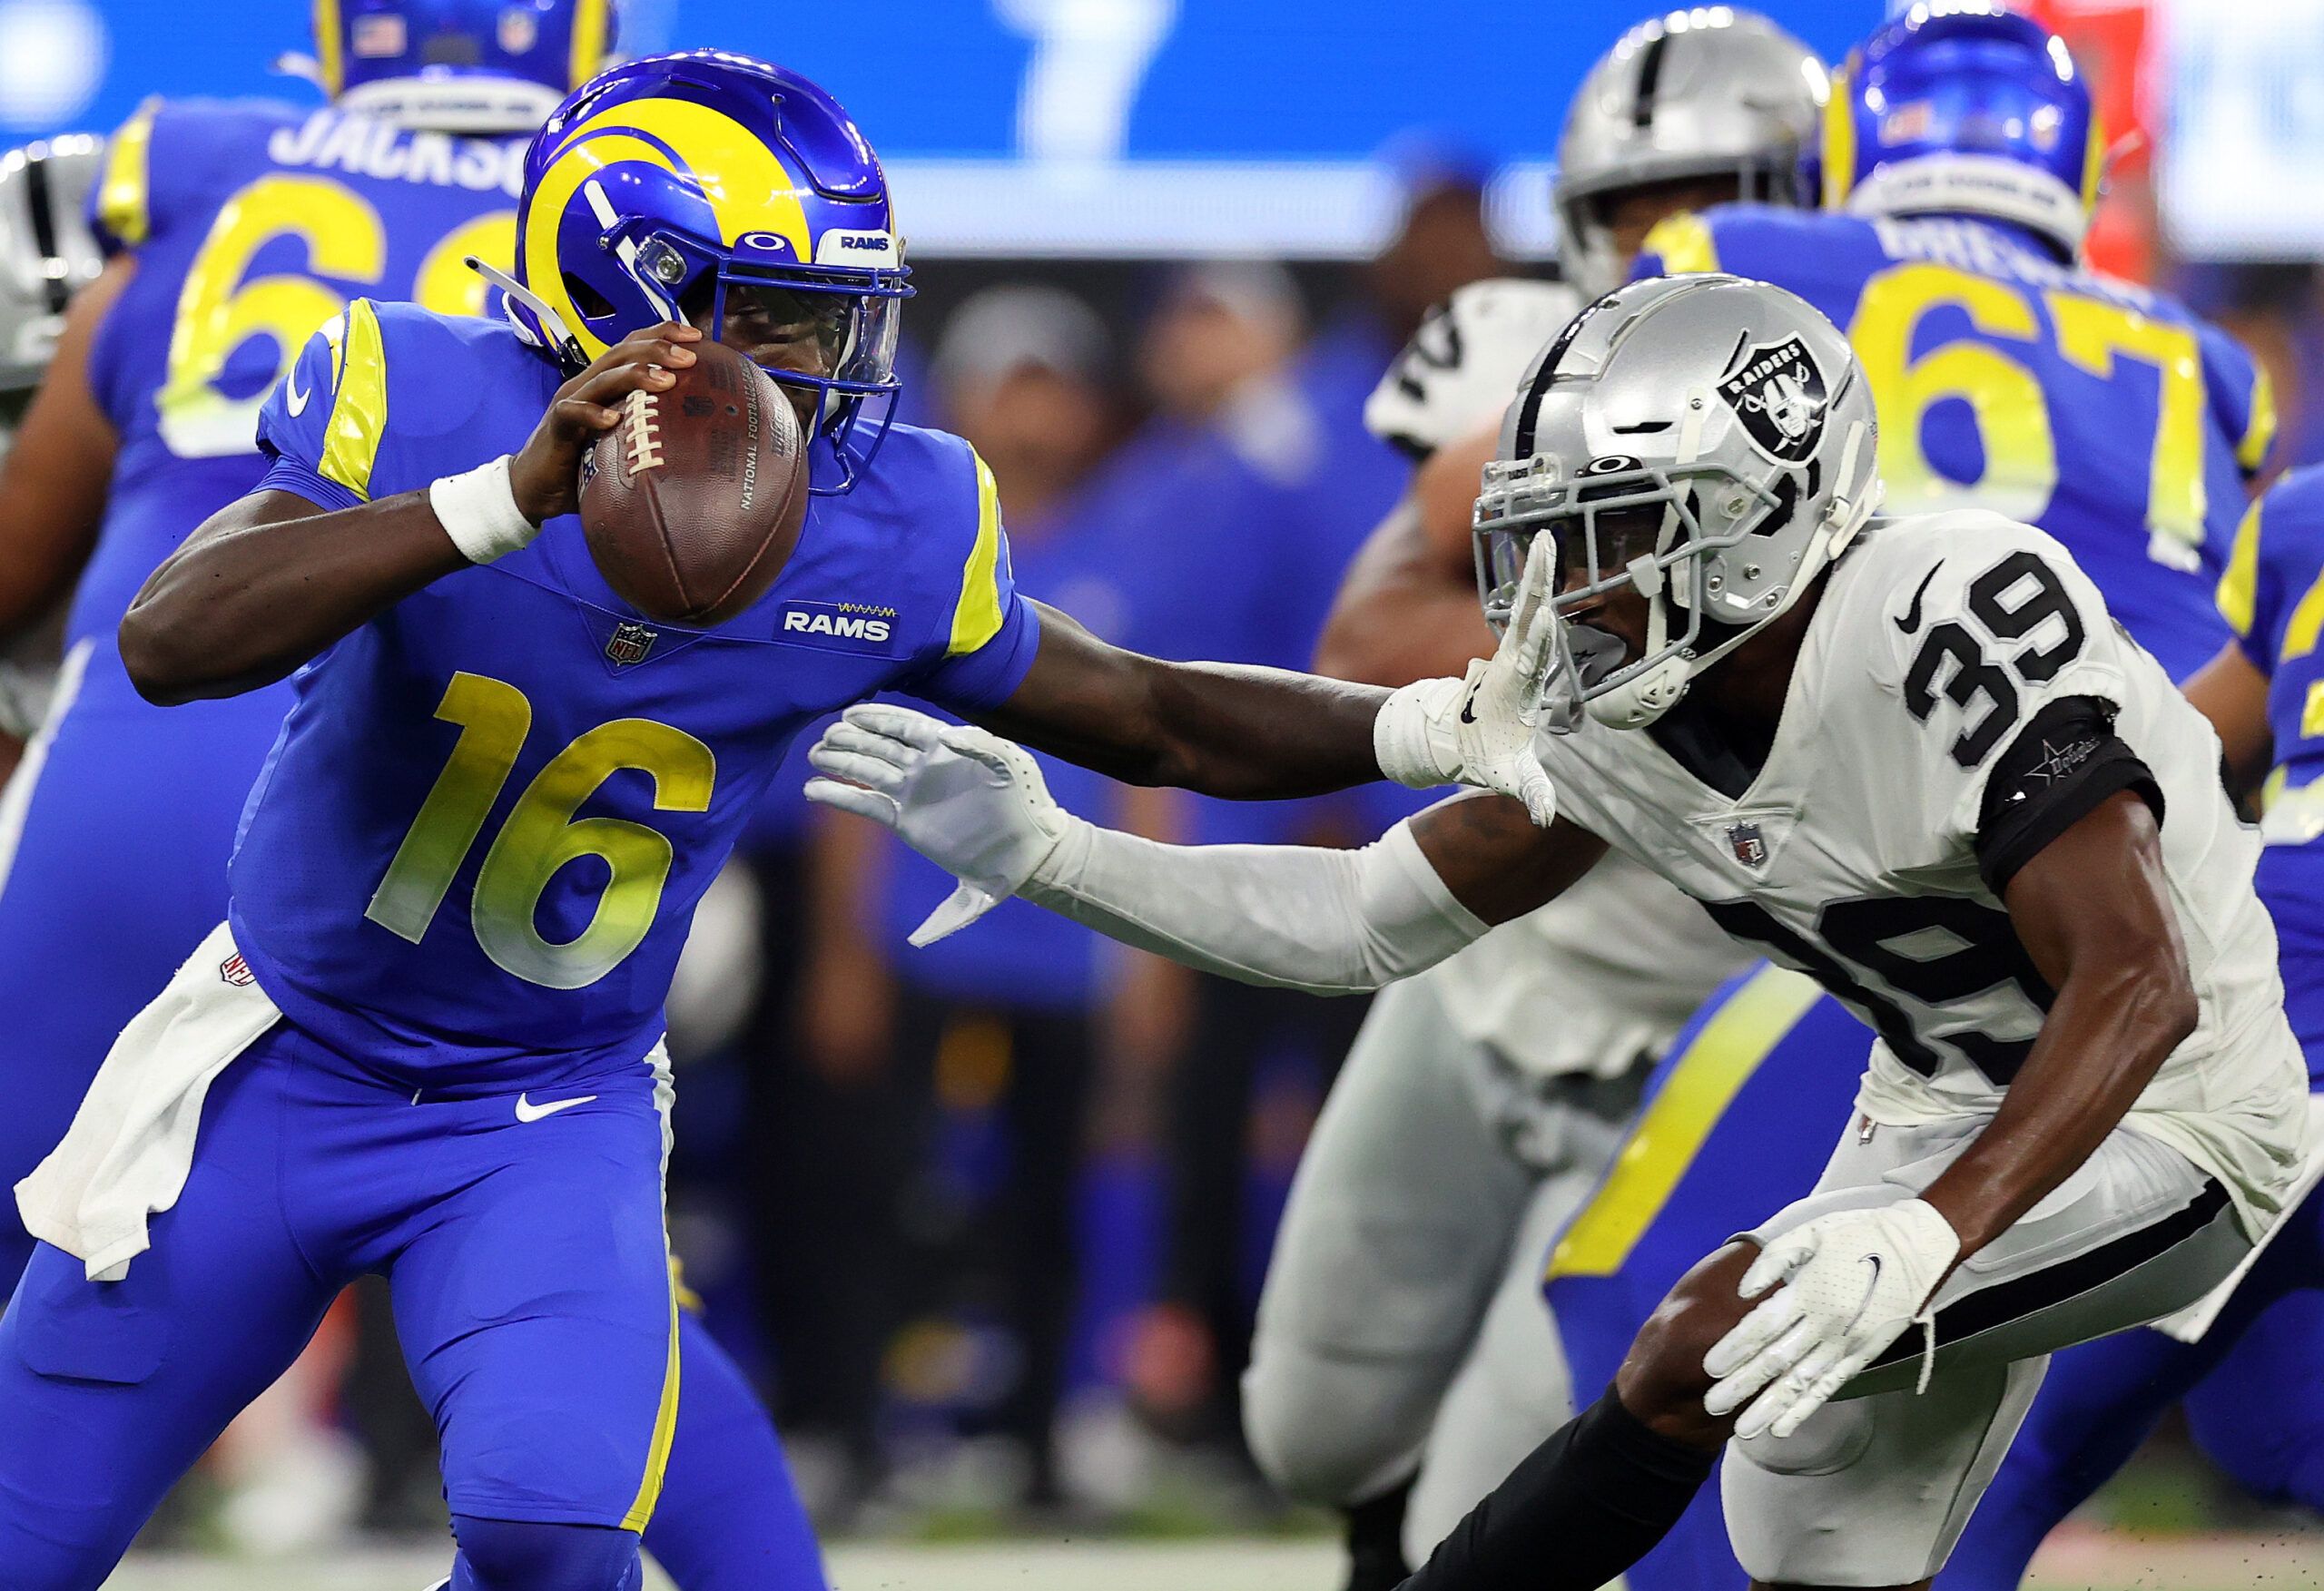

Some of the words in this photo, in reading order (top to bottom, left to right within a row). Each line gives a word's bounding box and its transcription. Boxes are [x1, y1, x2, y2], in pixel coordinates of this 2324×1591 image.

[841, 236, 889, 251] RAMS
[1727, 343, 1801, 395] RAIDERS
[745, 386, 759, 440] FOOTBALL
[1845, 261, 2208, 574] 67
[740, 445, 758, 511] NATIONAL
[783, 611, 891, 642] RAMS
[1904, 549, 2088, 771] 39
[364, 670, 717, 990] 16
